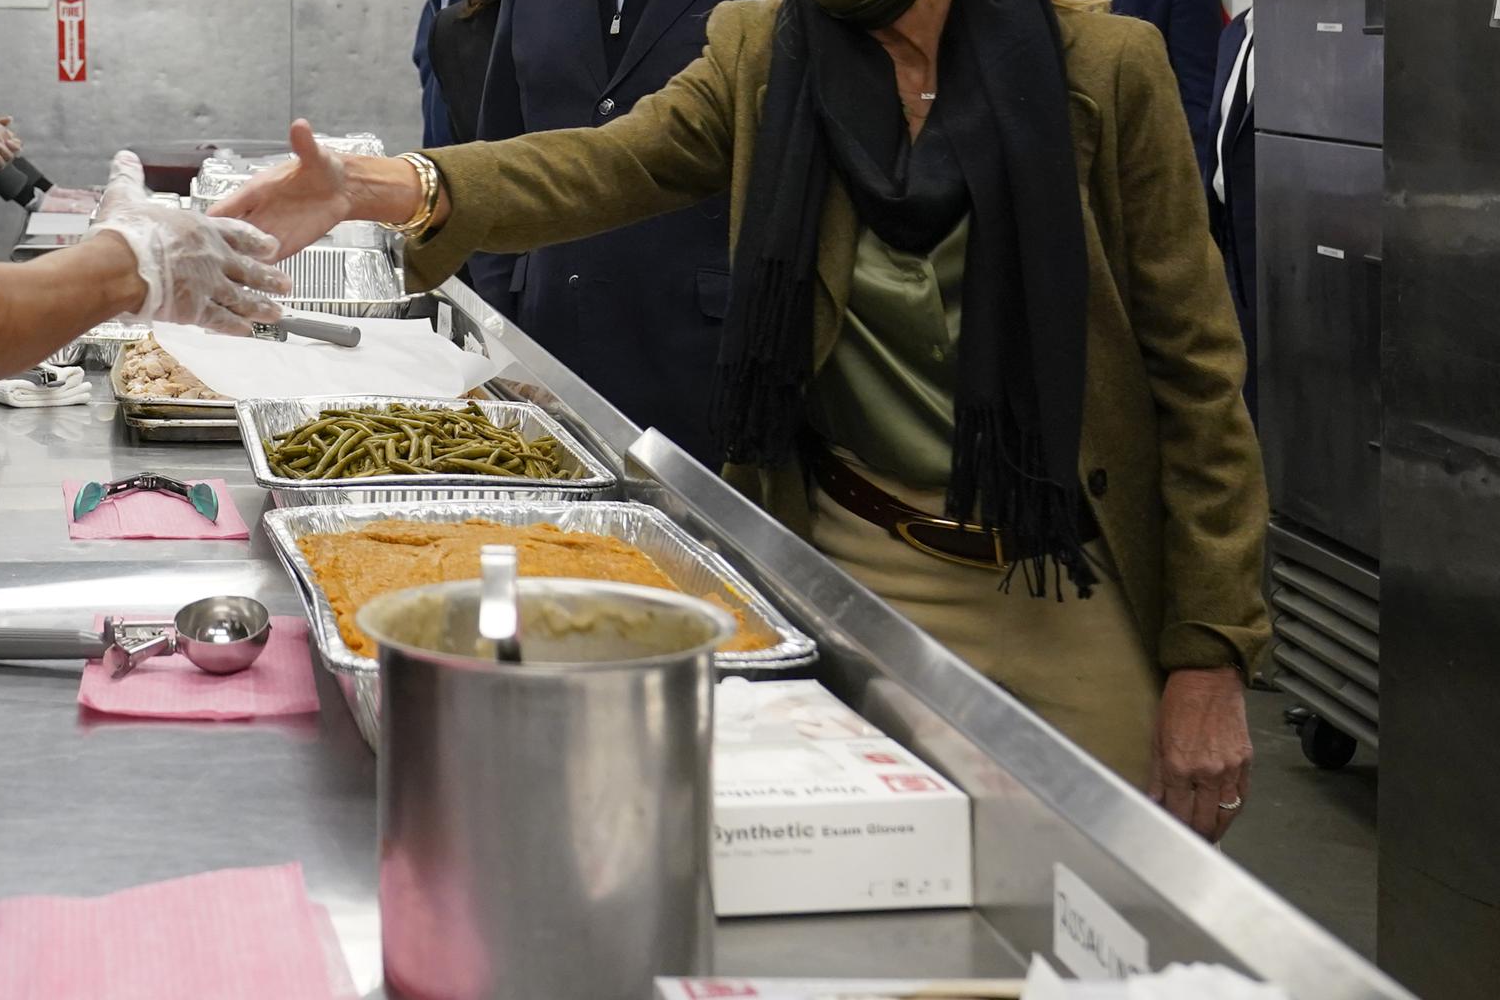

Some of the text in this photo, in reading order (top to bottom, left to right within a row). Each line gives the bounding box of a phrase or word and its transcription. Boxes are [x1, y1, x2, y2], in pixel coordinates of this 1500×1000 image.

[61, 6, 80, 17] FIRE
[821, 825, 862, 837] Exam
[866, 823, 915, 834] Gloves
